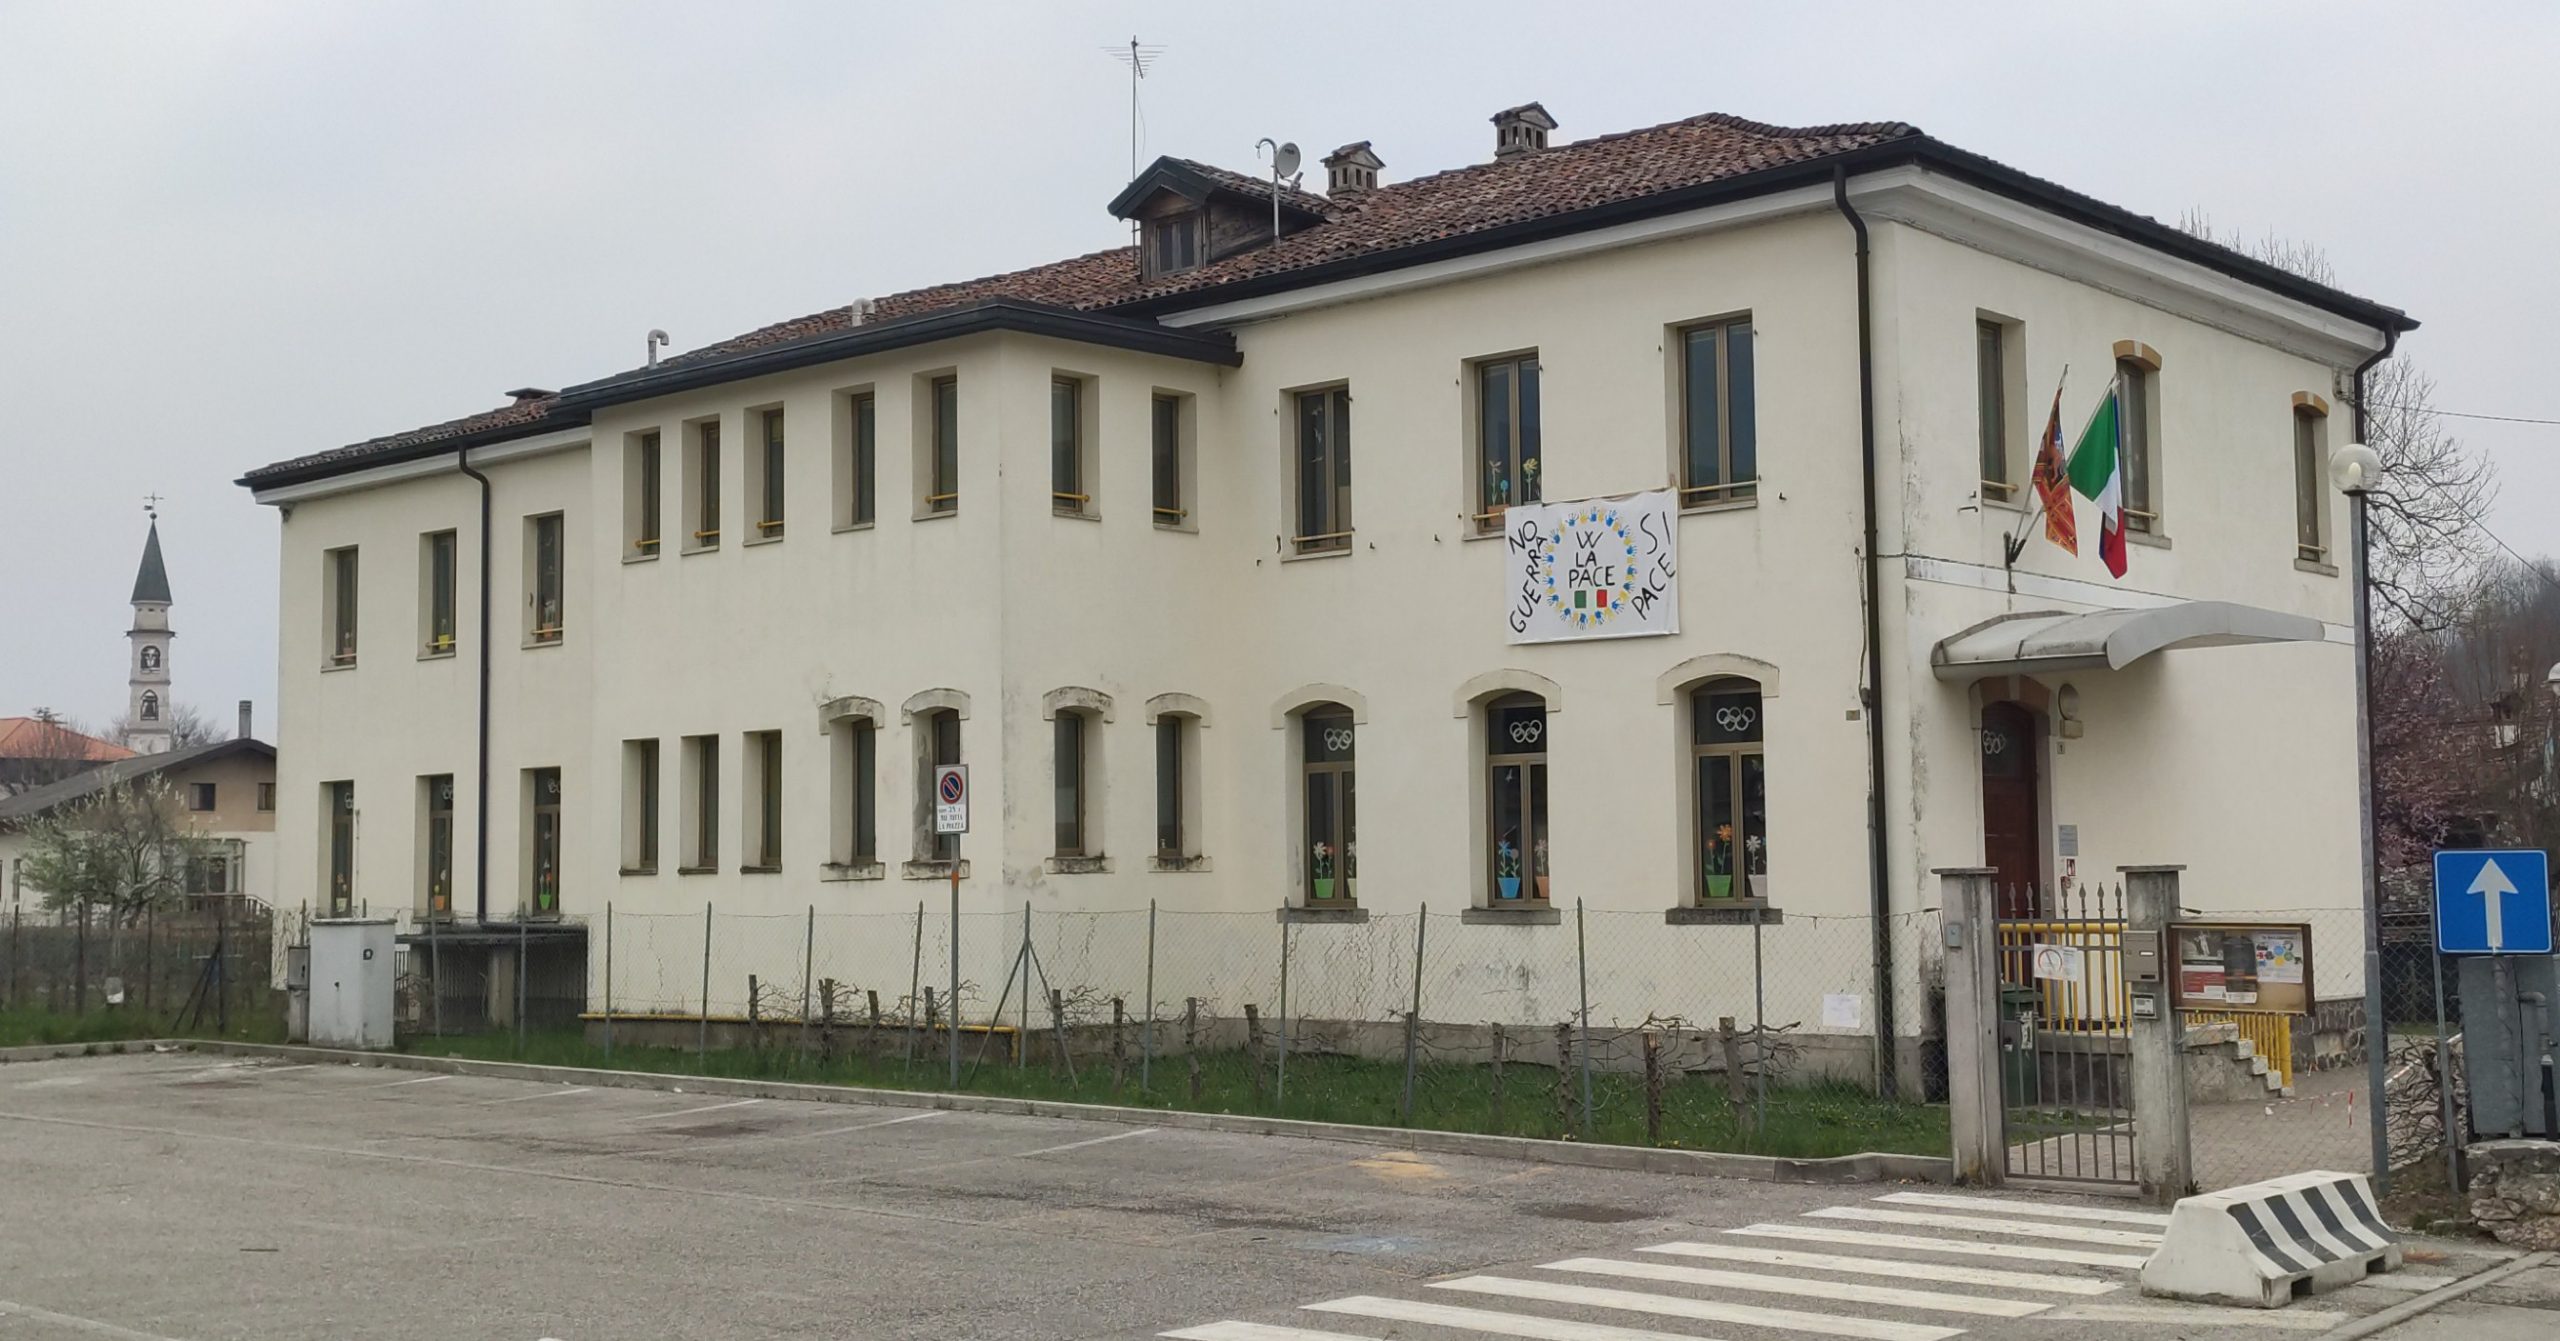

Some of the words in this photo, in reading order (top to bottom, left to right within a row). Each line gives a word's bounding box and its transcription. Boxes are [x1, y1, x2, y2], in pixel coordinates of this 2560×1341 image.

[1509, 520, 1537, 554] NO
[1640, 511, 1671, 555] SI
[1569, 565, 1615, 588] PACE
[1576, 551, 1597, 568] LA
[1509, 536, 1547, 633] GUERRA
[1631, 553, 1676, 620] PACE
